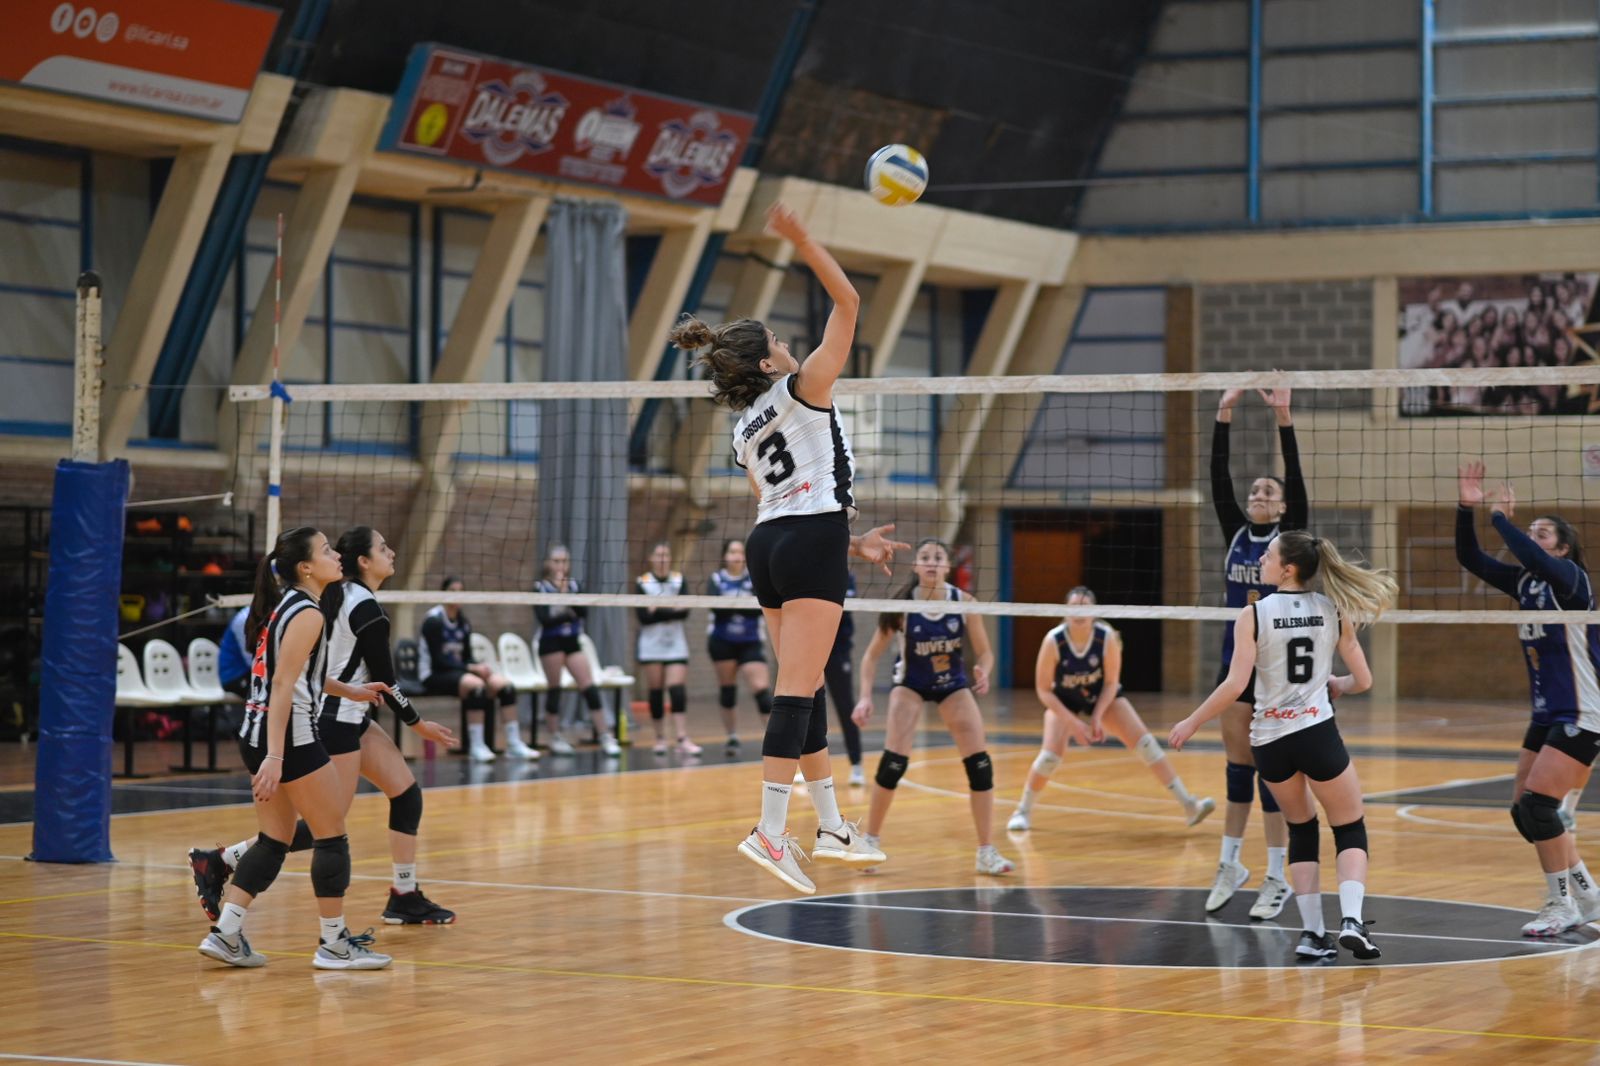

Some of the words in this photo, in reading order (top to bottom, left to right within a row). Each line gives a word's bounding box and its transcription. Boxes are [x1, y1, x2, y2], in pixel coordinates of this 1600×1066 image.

[464, 91, 567, 144] DALEMAS
[646, 127, 738, 178] DALEMAS
[757, 431, 796, 487] 3
[1227, 563, 1264, 585] JUVE
[1287, 637, 1314, 684] 6
